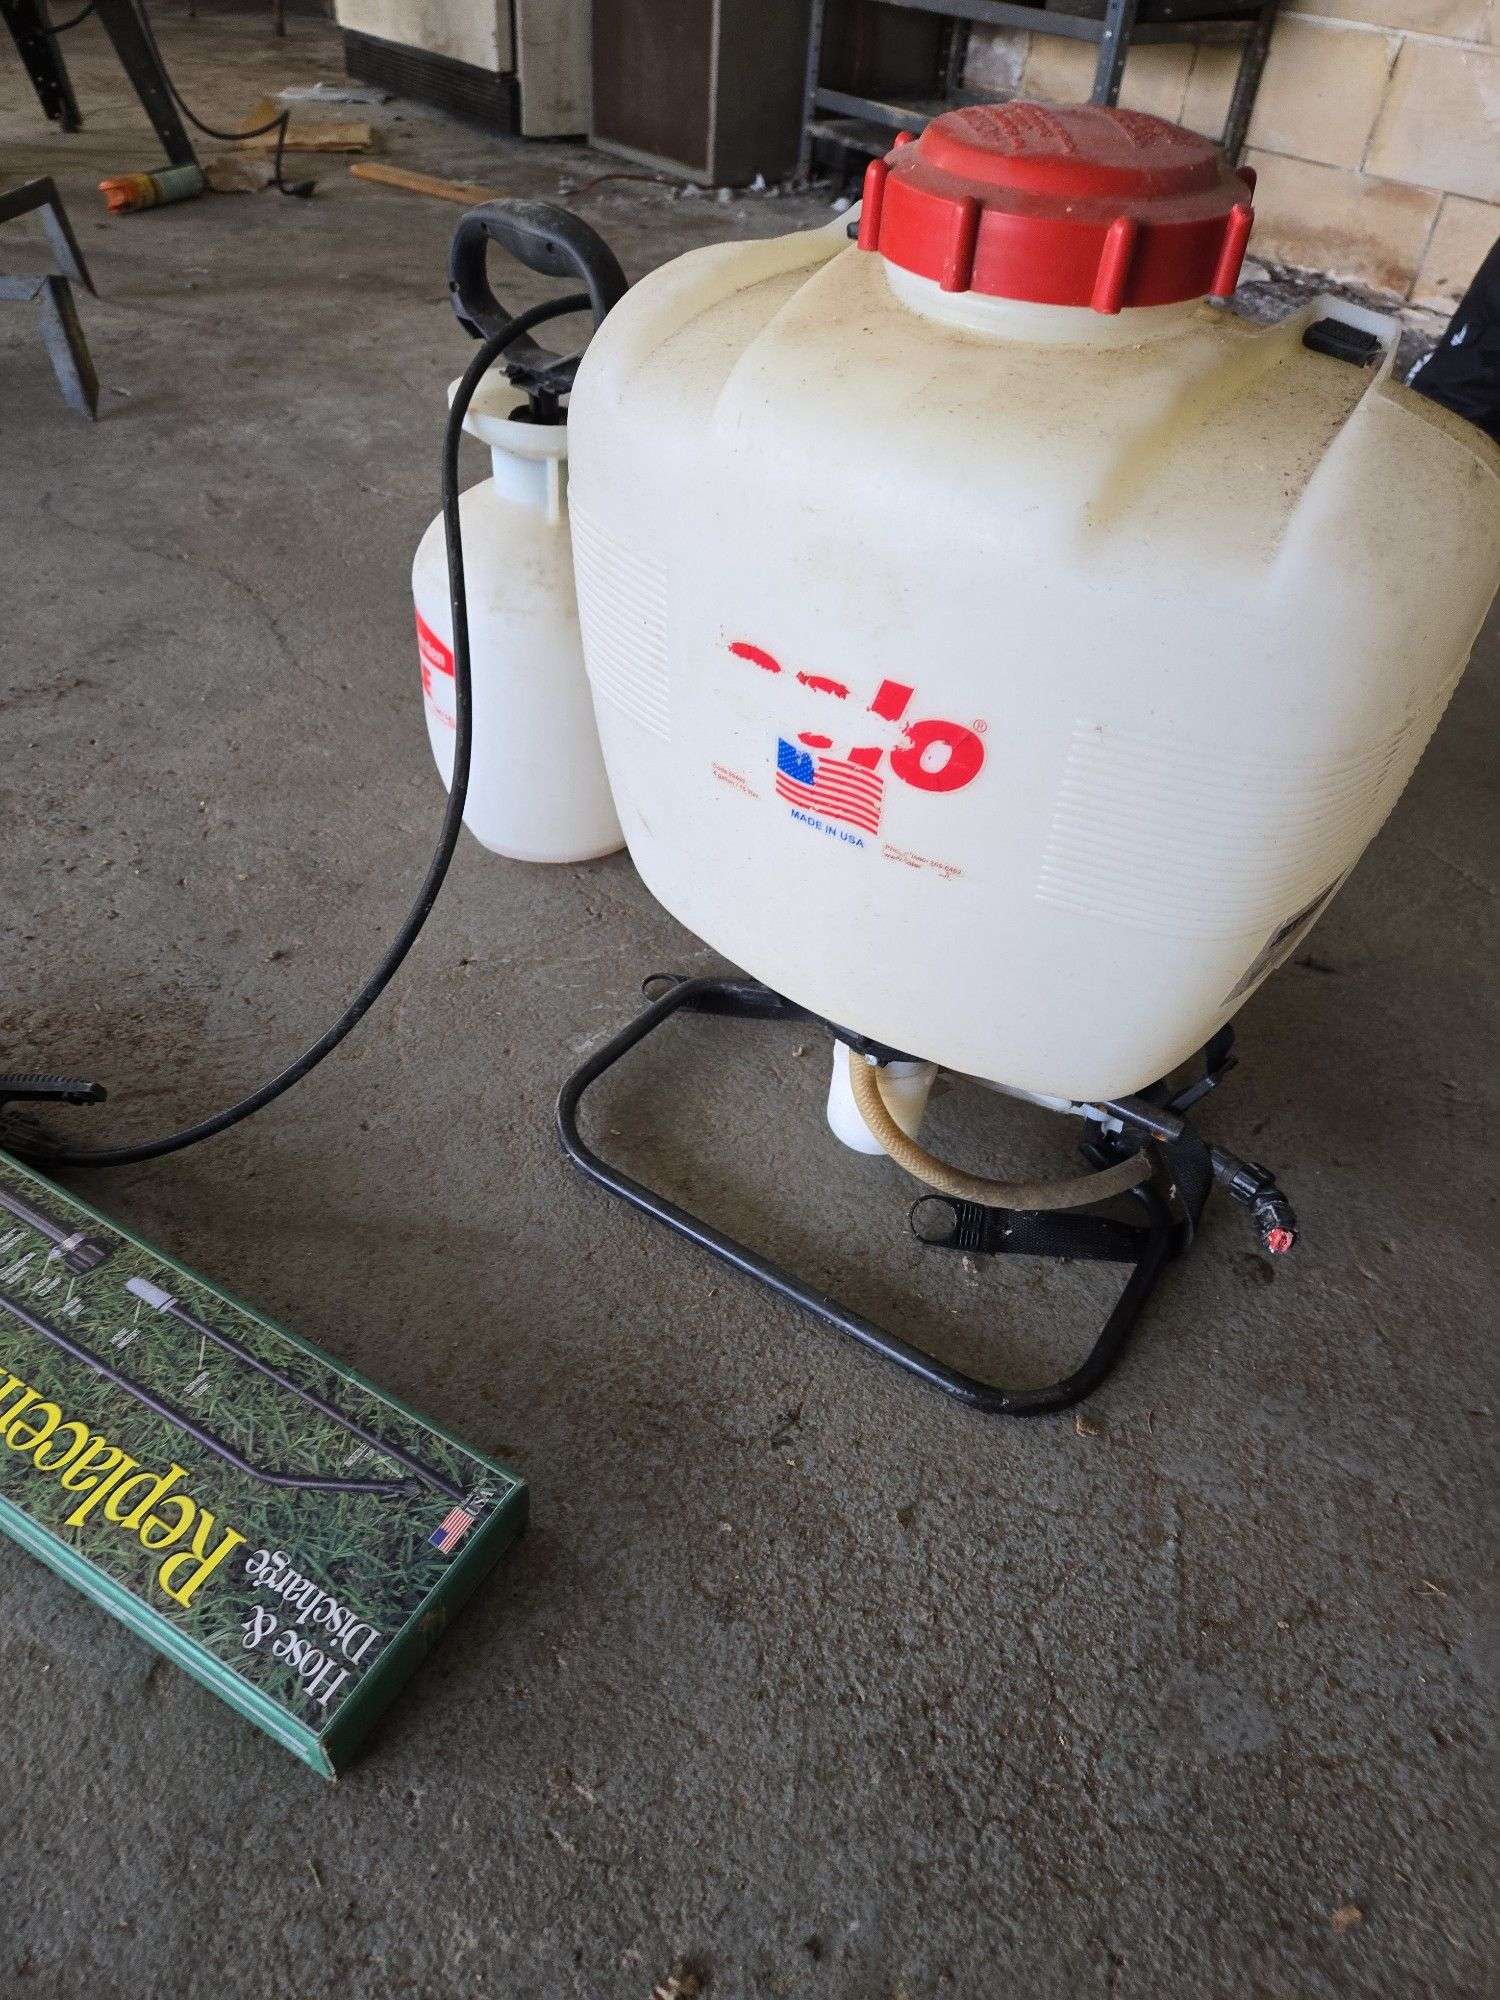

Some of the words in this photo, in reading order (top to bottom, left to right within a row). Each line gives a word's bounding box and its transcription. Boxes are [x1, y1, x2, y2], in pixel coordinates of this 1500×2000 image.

[790, 808, 823, 830] MADE
[825, 825, 837, 837] IN
[840, 831, 864, 848] USA
[241, 1605, 278, 1649] &
[245, 1549, 382, 1666] Discharge
[272, 1629, 351, 1707] Hose
